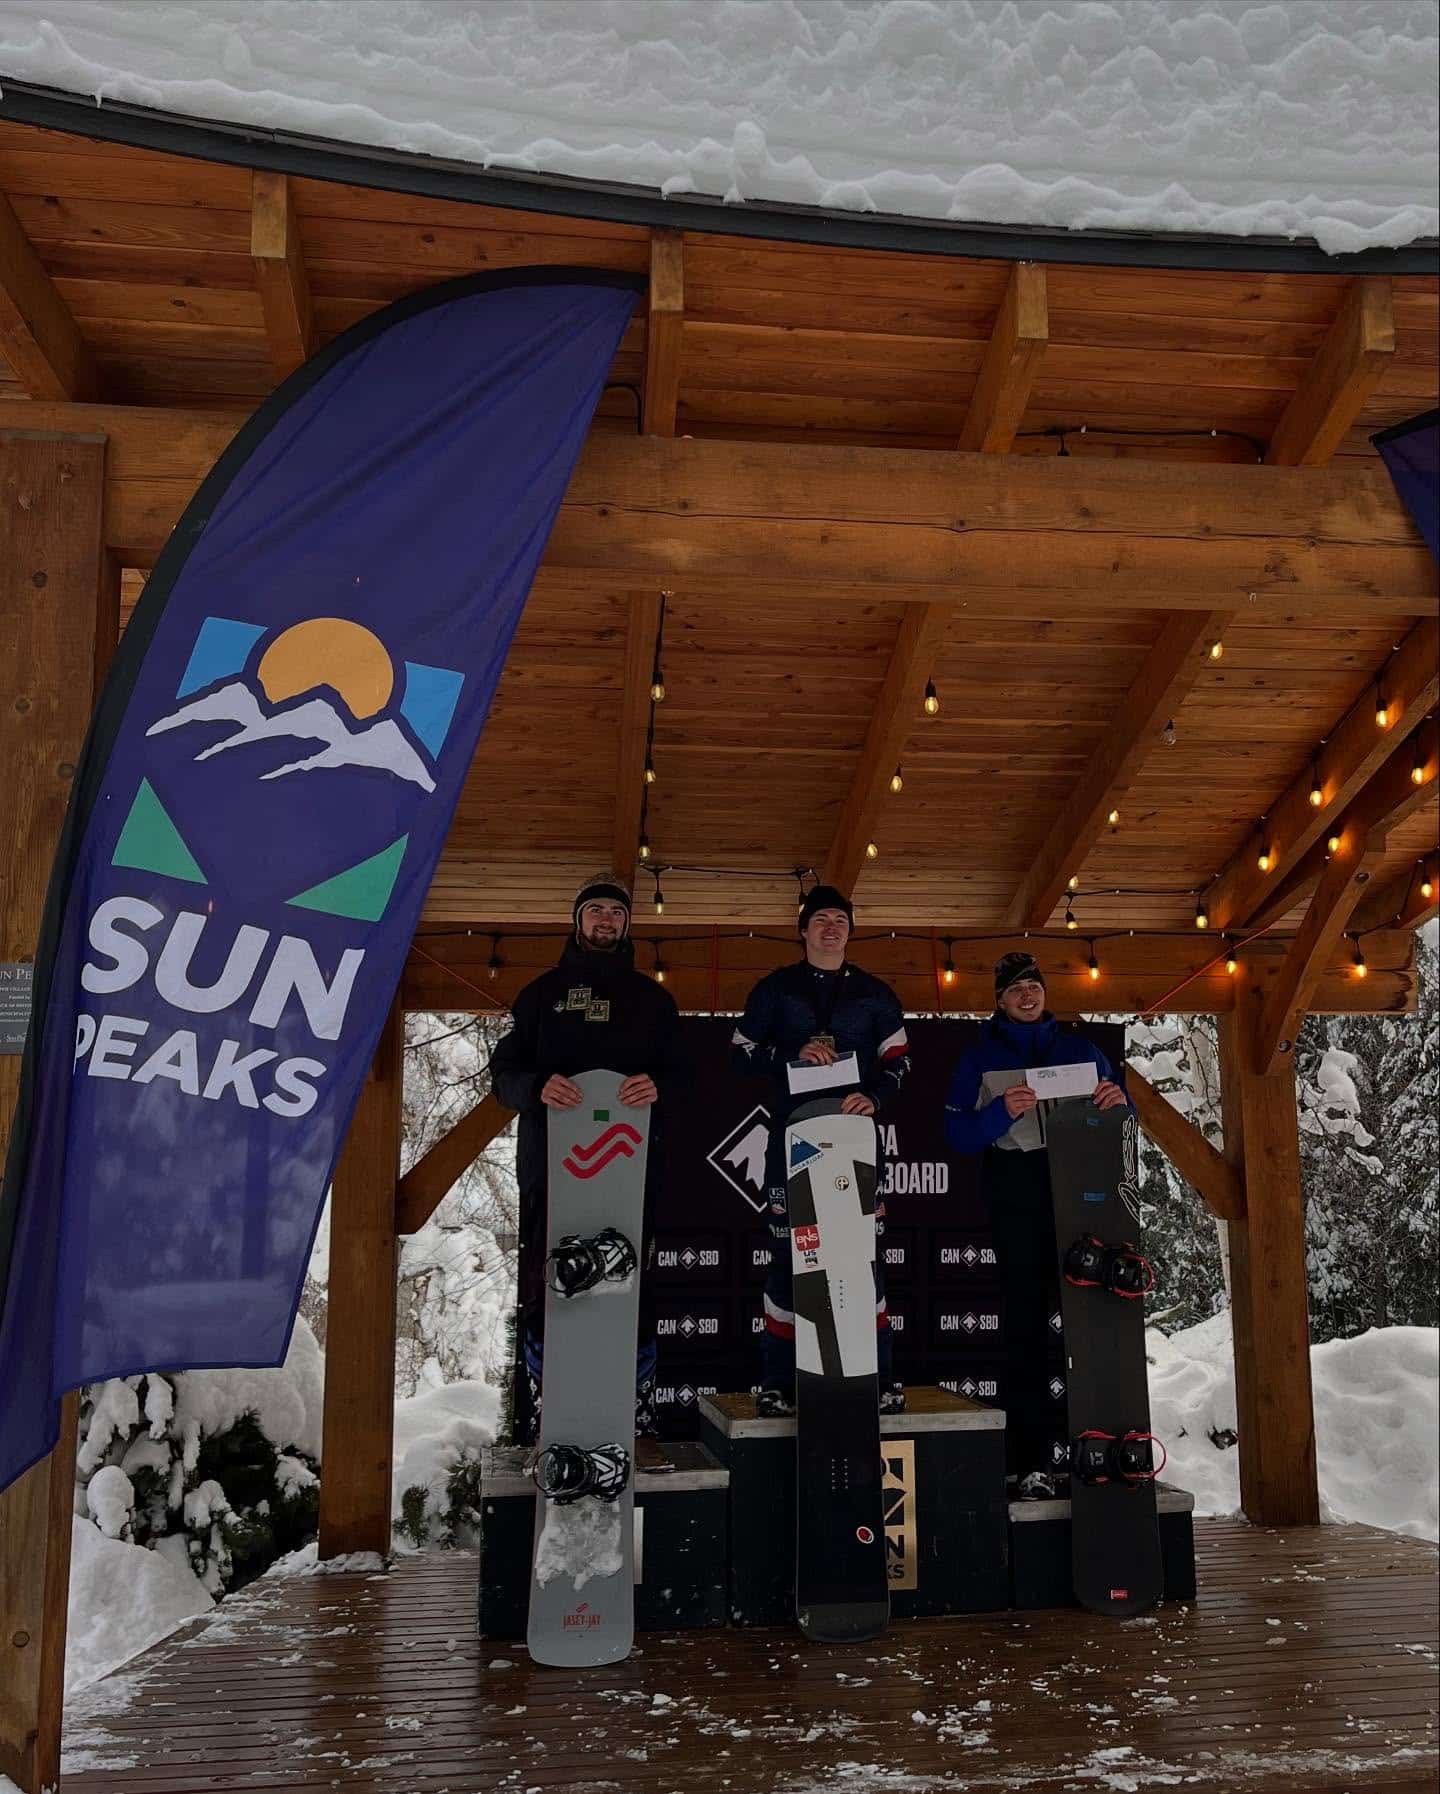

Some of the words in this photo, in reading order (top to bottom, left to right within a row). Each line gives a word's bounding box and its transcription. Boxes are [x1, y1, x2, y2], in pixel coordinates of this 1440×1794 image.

[81, 896, 365, 1041] SUN
[73, 1013, 327, 1118] PEAKS
[657, 1250, 678, 1267] CAN
[699, 1249, 719, 1266] SBD
[885, 1248, 905, 1264] SBD
[940, 1248, 960, 1264] CAN
[656, 1318, 677, 1335] CAN
[697, 1317, 718, 1334] SBD
[940, 1314, 959, 1330] CAN
[979, 1314, 999, 1330] SBD
[655, 1387, 675, 1403] CAN
[978, 1381, 997, 1397] SBD
